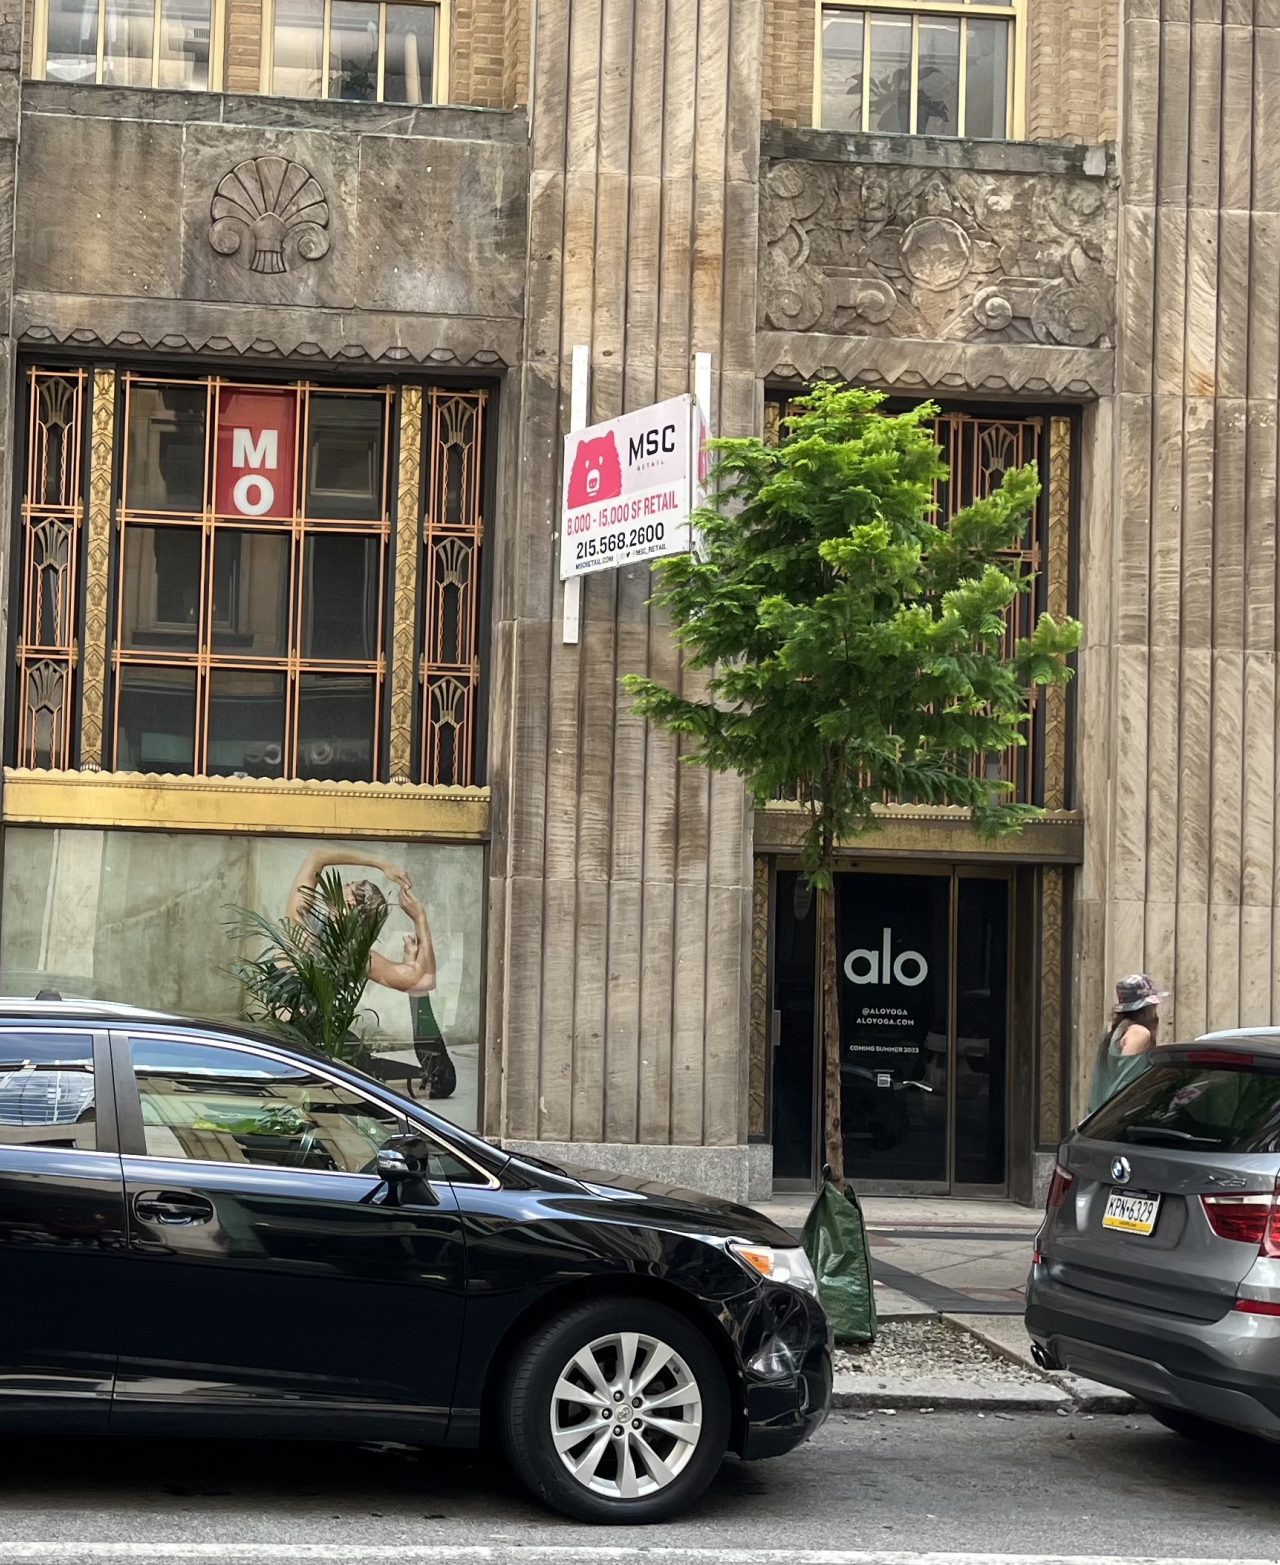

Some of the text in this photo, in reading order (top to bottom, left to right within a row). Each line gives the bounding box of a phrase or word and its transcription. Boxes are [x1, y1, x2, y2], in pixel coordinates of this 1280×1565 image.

[628, 424, 676, 466] MSC
[232, 428, 279, 516] MO
[631, 499, 642, 519] SF
[644, 491, 678, 516] RETAIL
[576, 522, 665, 560] 215.568.2600
[844, 927, 929, 987] alo
[856, 1017, 915, 1026] ALOYOGA.COM
[862, 1007, 908, 1016] @ALOYOGA
[850, 1044, 875, 1052] COMING
[876, 1045, 903, 1053] SUMMER
